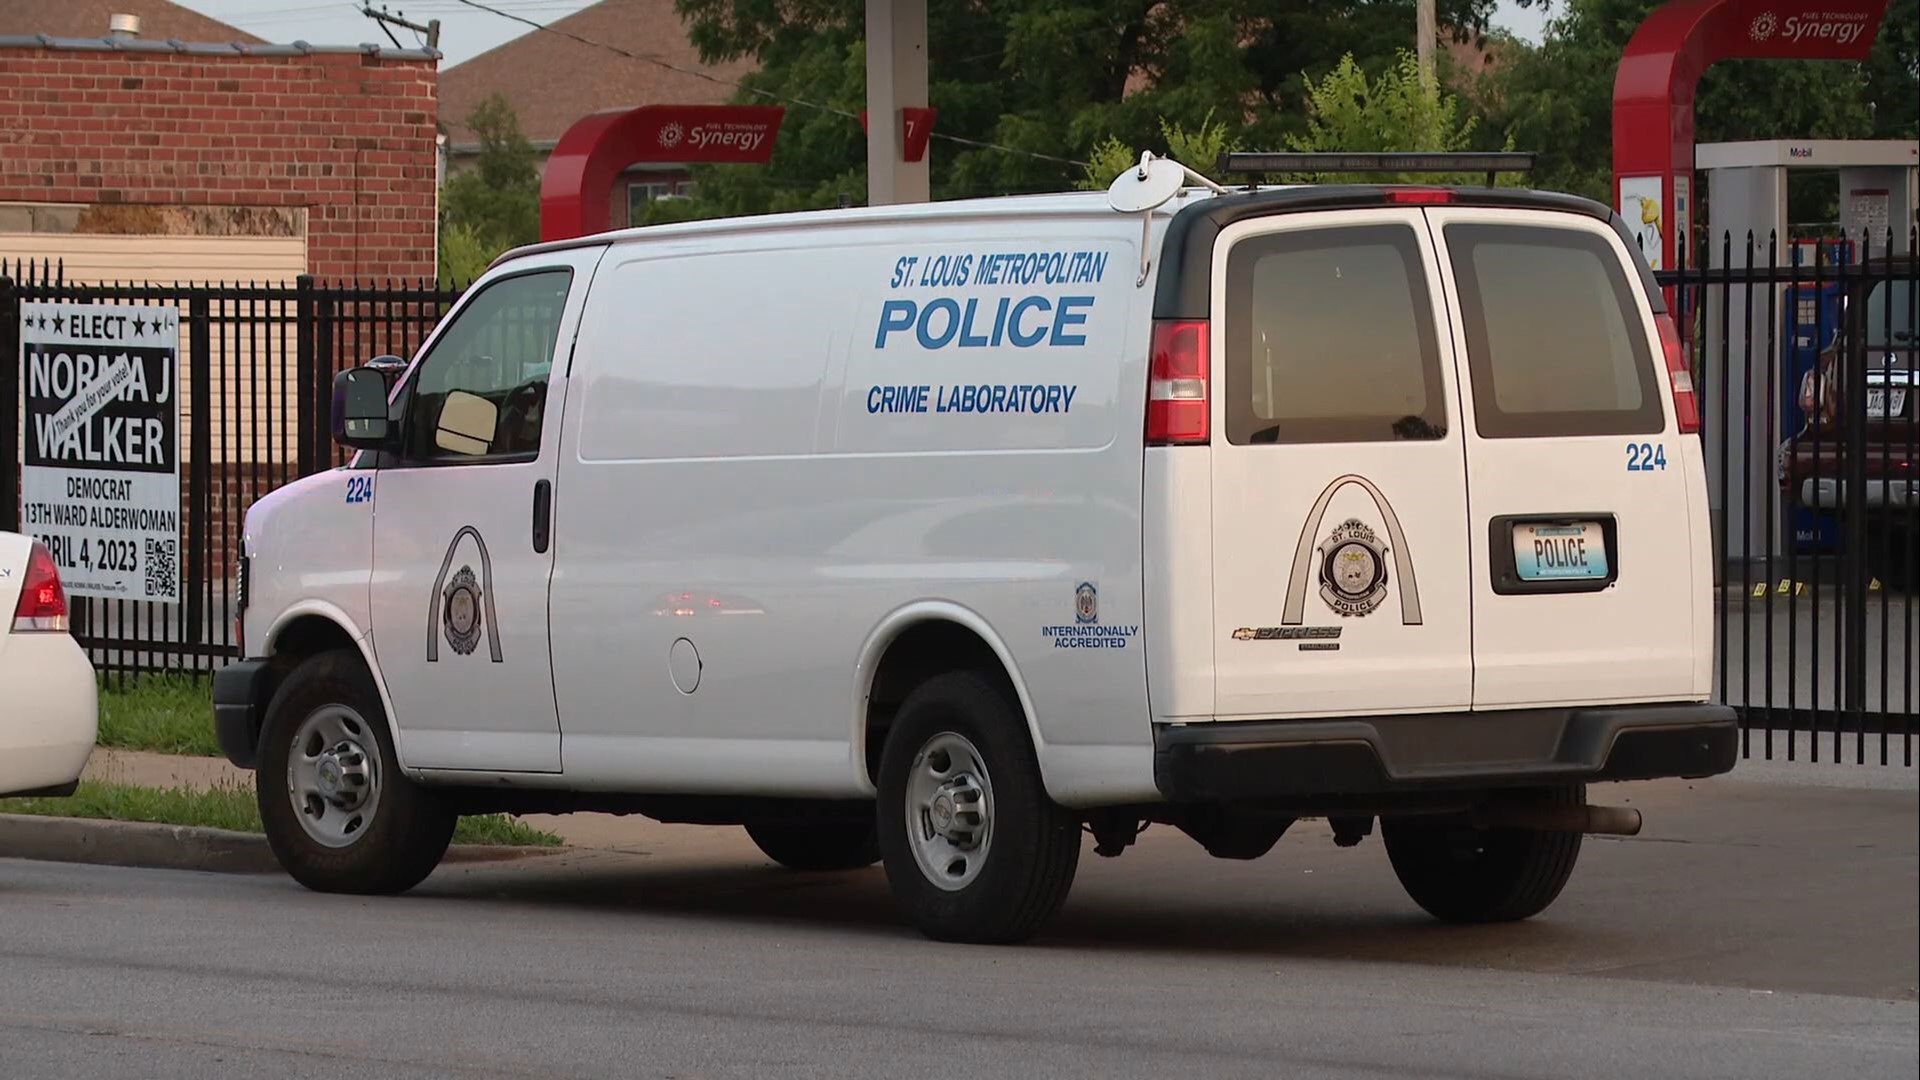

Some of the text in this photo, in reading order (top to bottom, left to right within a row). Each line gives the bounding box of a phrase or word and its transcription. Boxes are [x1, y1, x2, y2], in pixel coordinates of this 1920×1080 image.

[1781, 16, 1866, 44] Synergy
[687, 126, 765, 151] Synergy
[906, 121, 915, 138] 7
[1790, 148, 1813, 158] Mobil
[891, 252, 1108, 288] ST. LOUIS METROPOLITAN
[70, 315, 126, 339] ELECT
[875, 296, 1095, 349] POLICE
[156, 357, 170, 404] J
[867, 384, 1077, 413] CRIME LABORATORY
[35, 414, 164, 464] WALKER
[1626, 443, 1667, 471] 224
[66, 477, 132, 501] DEMOCRAT
[346, 477, 372, 503] 224
[24, 503, 176, 532] 13TH WARD ALDERWOMAN
[1348, 531, 1375, 543] LOUIS
[80, 538, 93, 573] 4,
[98, 539, 137, 572] 2023
[1534, 538, 1588, 568] POLICE
[1334, 599, 1374, 612] POLICE
[1042, 626, 1139, 637] INTERNATIONALLY
[1054, 638, 1126, 648] ACCREDITED
